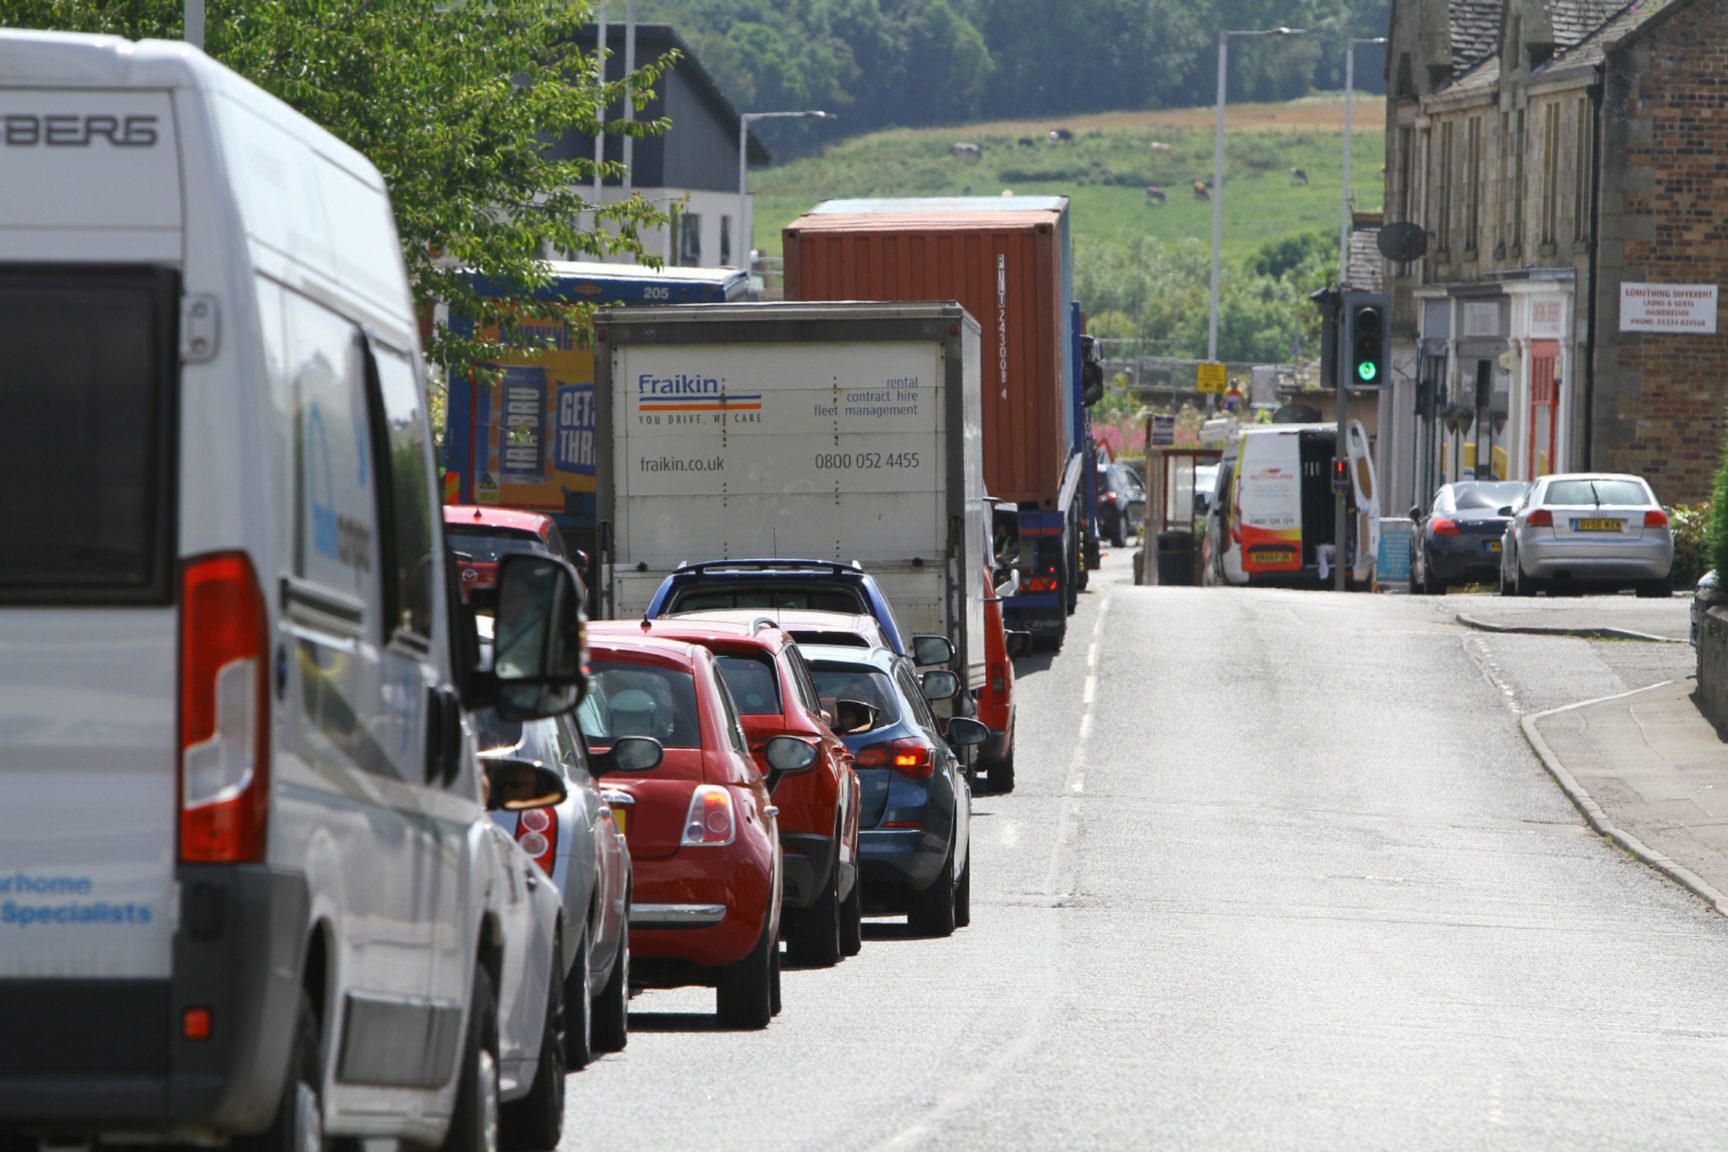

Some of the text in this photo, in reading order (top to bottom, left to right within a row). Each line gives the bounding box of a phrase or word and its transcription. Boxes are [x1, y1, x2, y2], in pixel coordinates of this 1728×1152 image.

[0, 115, 158, 146] BERG
[643, 287, 669, 299] 205
[1625, 288, 1713, 299] SOMETHING DIFFERENT
[1645, 309, 1690, 317] HAIRDRESSER
[639, 374, 718, 394] Fraikin
[886, 377, 919, 389] rental
[847, 390, 918, 402] contract hire
[561, 391, 596, 427] GET
[814, 404, 918, 418] fleet management
[639, 413, 762, 425] YOU DRIVE, WE CARE
[505, 387, 540, 469] IRNBRU
[560, 430, 596, 465] THR
[640, 456, 724, 472] fraikin.co.uk
[815, 452, 920, 470] 0800 052 4455
[0, 872, 92, 894] rhome
[2, 900, 152, 928] Specialists
